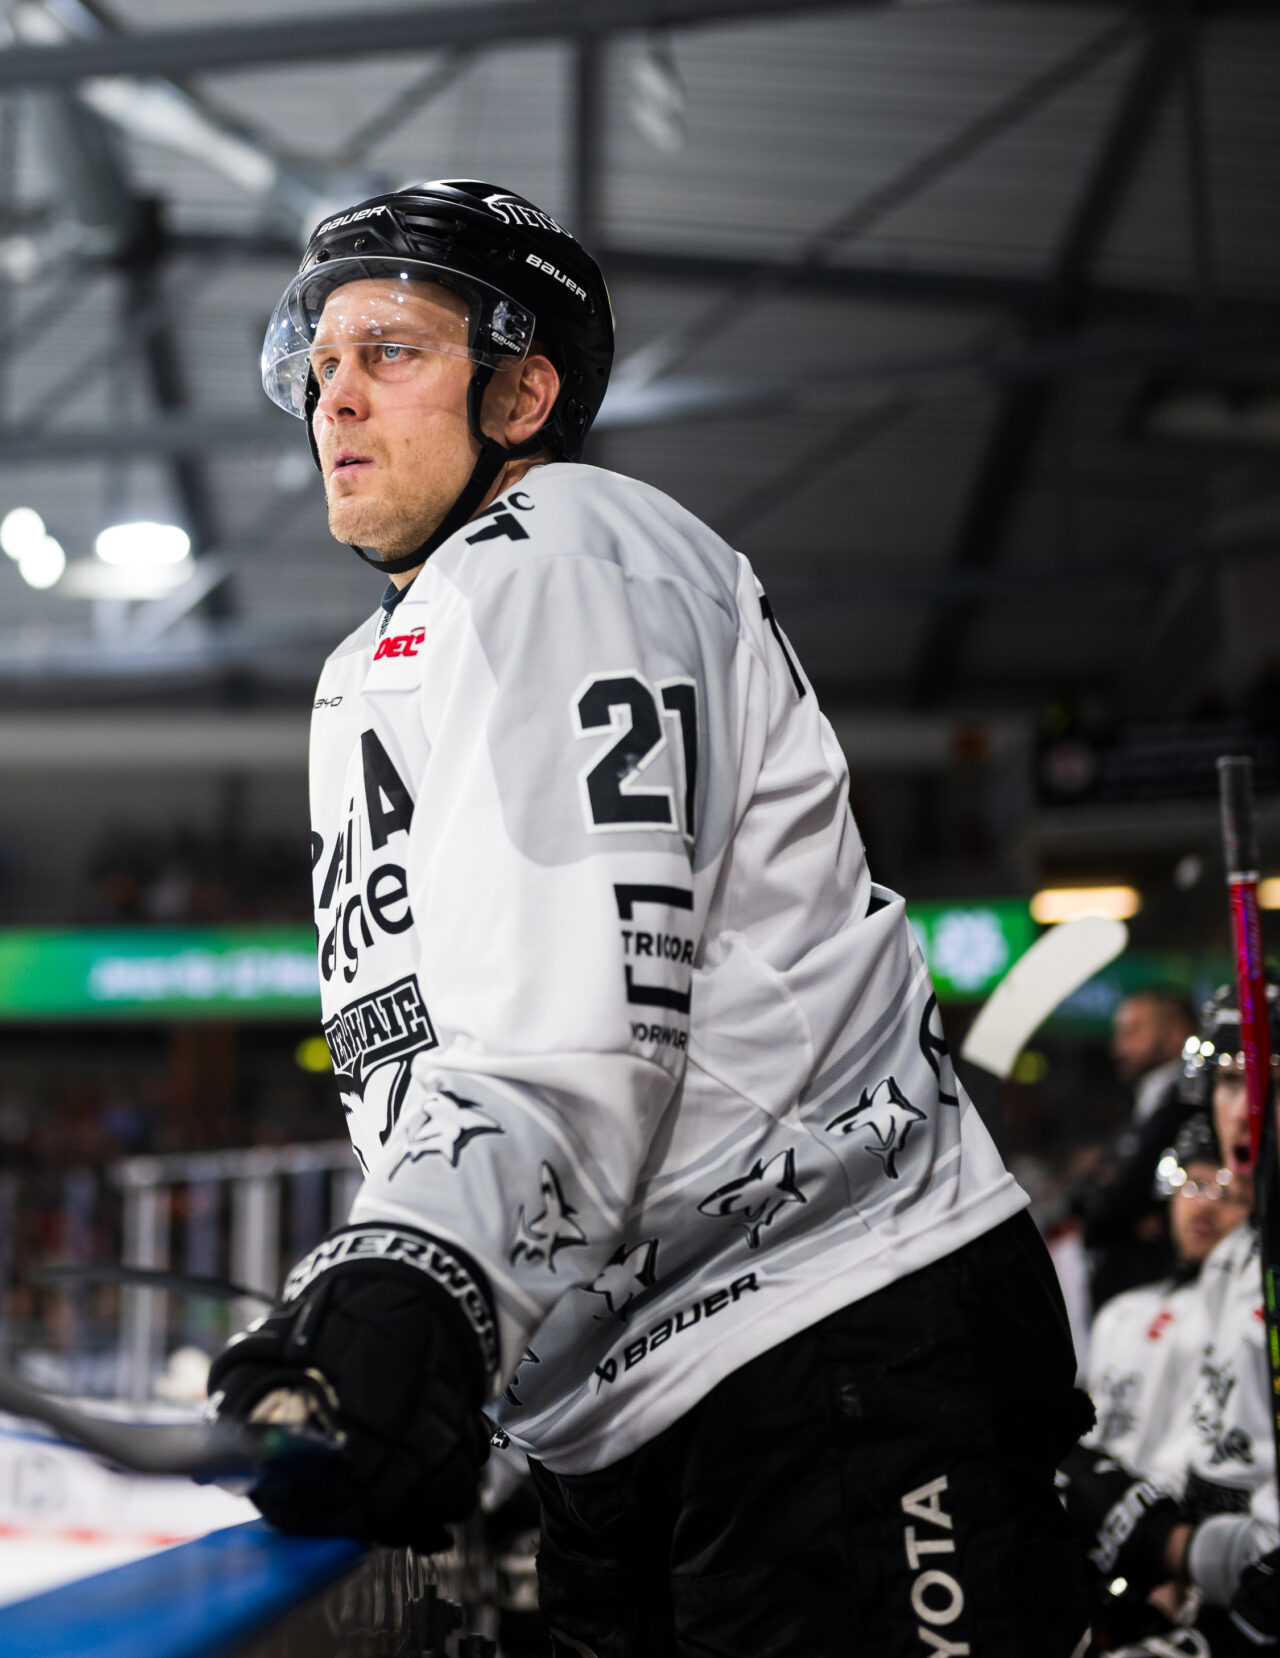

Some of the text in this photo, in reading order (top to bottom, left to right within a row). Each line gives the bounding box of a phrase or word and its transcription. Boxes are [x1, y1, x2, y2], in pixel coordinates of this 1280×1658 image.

[315, 205, 388, 238] BAUER
[525, 253, 588, 302] BAUER
[490, 331, 522, 353] BAUER
[507, 491, 536, 512] C
[572, 671, 699, 842] 21
[621, 929, 694, 966] TRICOR
[623, 1272, 760, 1372] BAUER
[900, 1473, 970, 1658] YOTA
